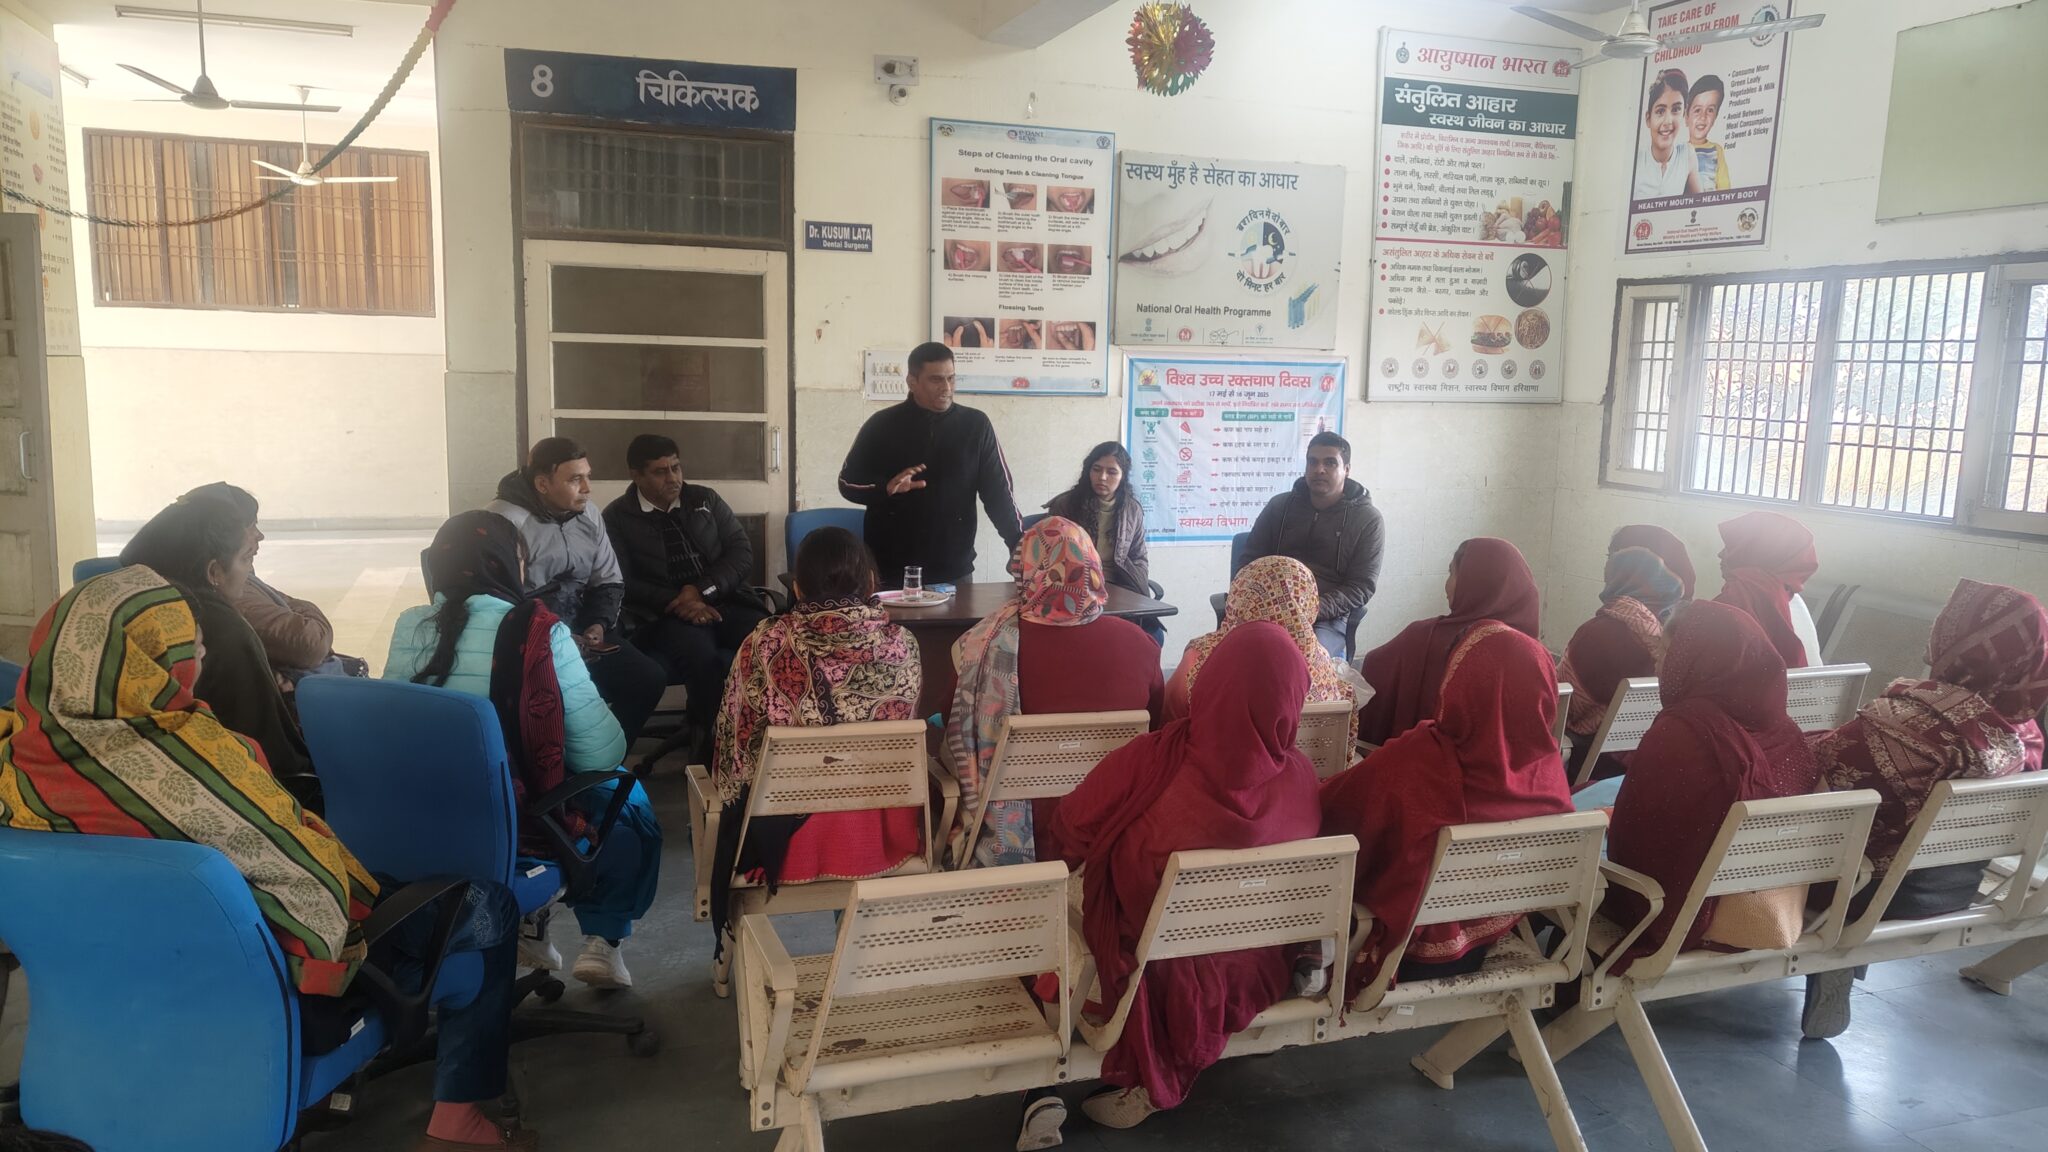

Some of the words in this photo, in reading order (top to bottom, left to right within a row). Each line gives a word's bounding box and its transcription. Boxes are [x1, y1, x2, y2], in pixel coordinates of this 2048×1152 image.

[1657, 13, 1678, 28] TAKE
[1680, 6, 1702, 23] CARE
[1705, 2, 1717, 16] OF
[1713, 14, 1740, 30] FROM
[1417, 48, 1497, 71] आयुष्मान
[1502, 56, 1549, 75] भारत
[531, 65, 554, 97] 8
[635, 69, 759, 113] चिकित्सक
[1395, 83, 1462, 113] संतुलित
[1466, 95, 1518, 113] आहार
[1429, 113, 1464, 127] स्वस्थ
[1468, 113, 1506, 130] जीवन
[1508, 120, 1527, 131] का
[1529, 122, 1567, 135] आधार
[958, 149, 982, 158] Steps
[995, 152, 1032, 162] Cleaning
[1069, 158, 1093, 166] cavity
[1125, 162, 1164, 180] स्वस्थ
[1167, 160, 1186, 189] मुँह
[1189, 161, 1199, 185] है
[1202, 163, 1235, 186] सेहत
[1238, 170, 1256, 187] का
[1259, 172, 1299, 190] आधार
[1638, 200, 1667, 210] HEALTHY
[1669, 198, 1694, 207] MOUTH
[1702, 193, 1736, 203] HEALTHY
[1737, 190, 1759, 199] BODY
[809, 225, 820, 239] Dr.
[822, 226, 850, 240] KUSUM
[852, 228, 872, 241] LATA
[823, 240, 842, 248] Dental
[844, 241, 869, 250] Surgeon
[1136, 303, 1172, 313] National
[1174, 305, 1192, 314] Oral
[1195, 305, 1221, 315] Health
[1223, 306, 1271, 318] Programme
[1166, 368, 1196, 385] विश्व
[1200, 374, 1224, 386] उच्च
[1227, 374, 1275, 387] रक्तचाप
[1279, 370, 1311, 388] दिवस
[1178, 518, 1213, 529] स्वास्थ्य
